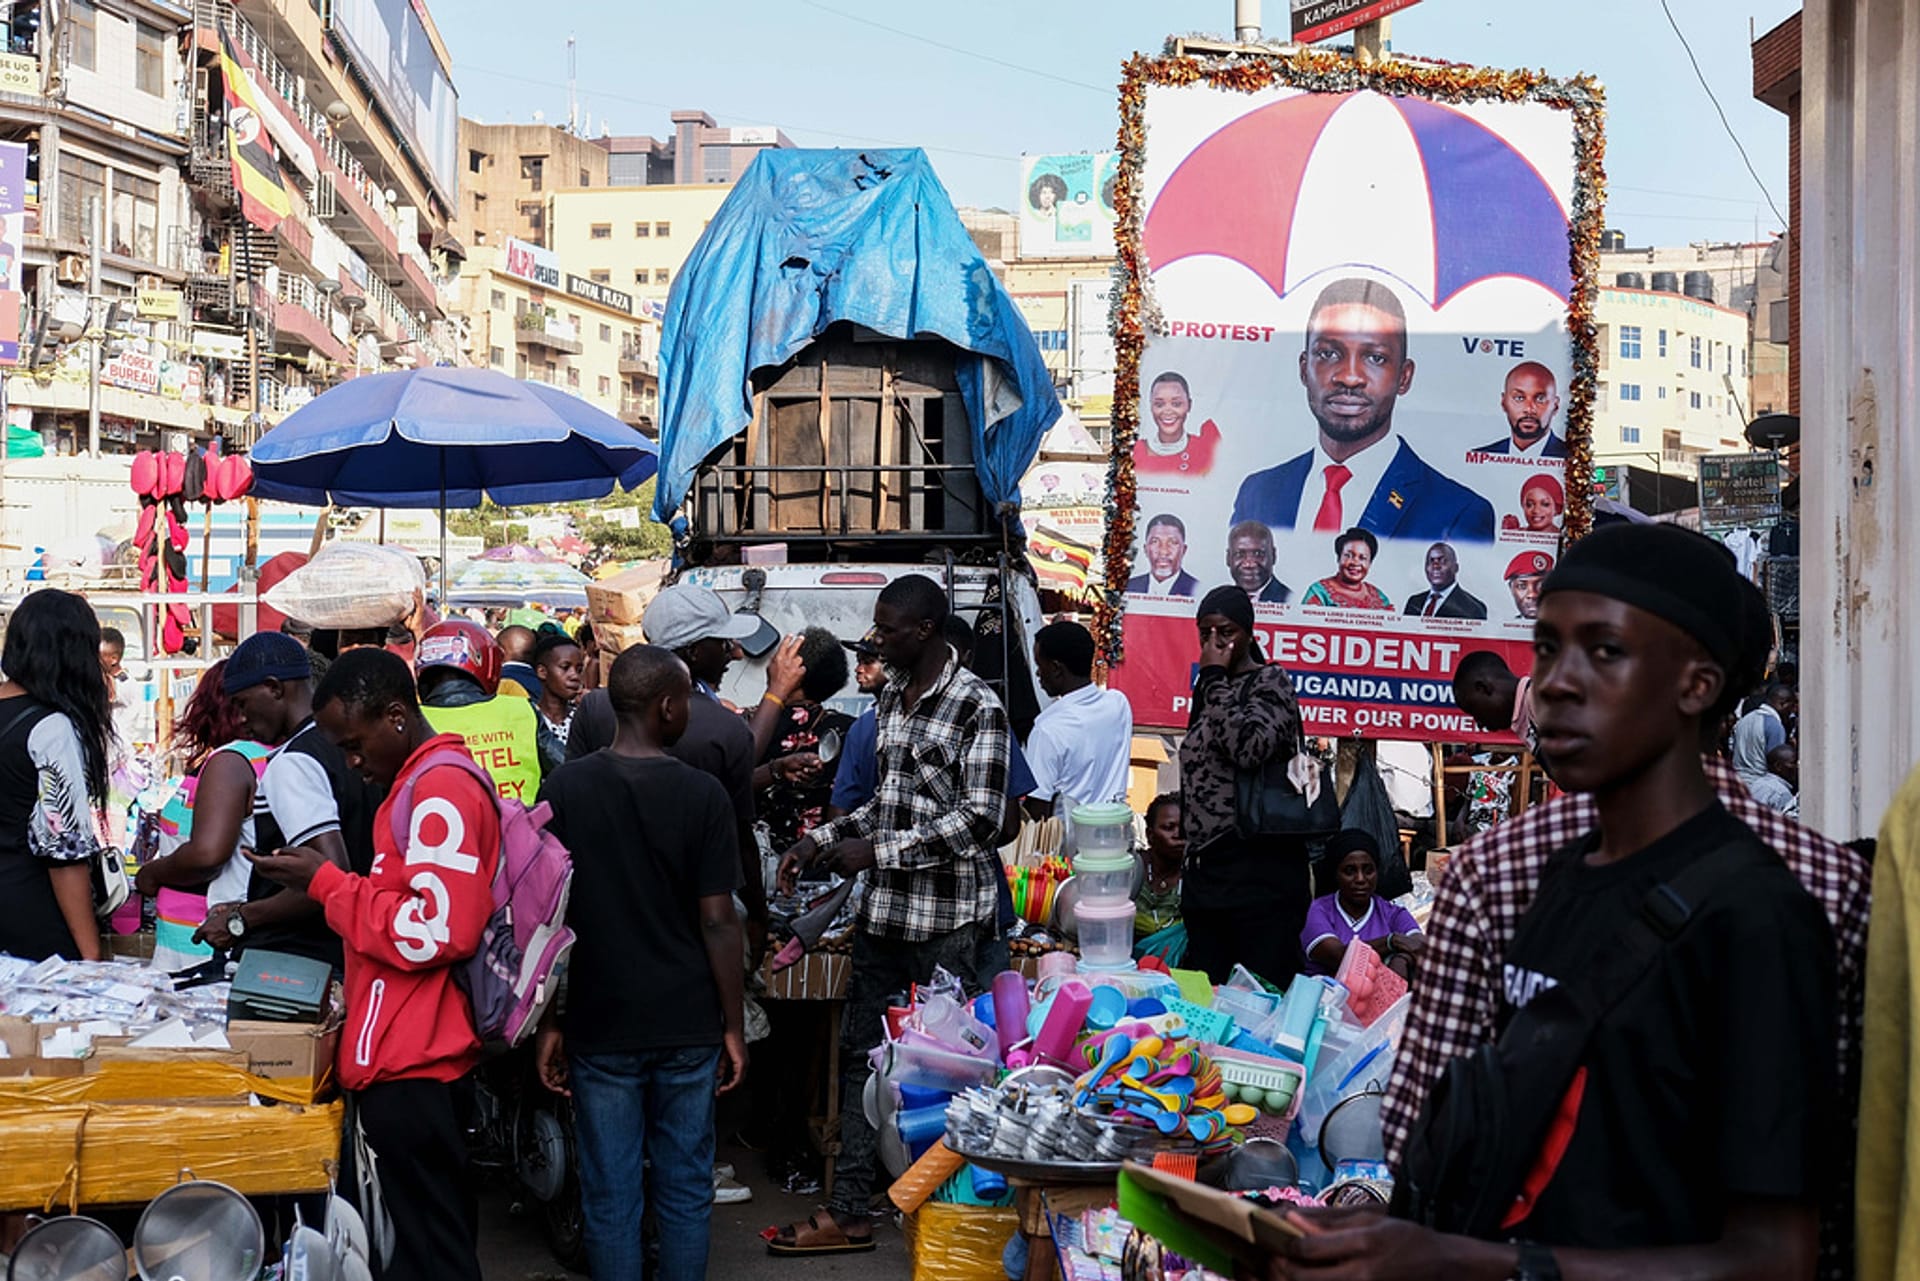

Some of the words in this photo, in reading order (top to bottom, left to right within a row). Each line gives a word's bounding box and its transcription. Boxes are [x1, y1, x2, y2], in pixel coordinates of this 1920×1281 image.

[571, 277, 601, 301] ROYAL
[602, 288, 630, 311] PLAZA
[1171, 321, 1276, 343] PROTEST
[121, 353, 154, 371] FOREX
[109, 364, 157, 386] BUREAU
[1401, 682, 1457, 705] NOW
[1354, 709, 1403, 728] OUR
[480, 730, 515, 745] WITH
